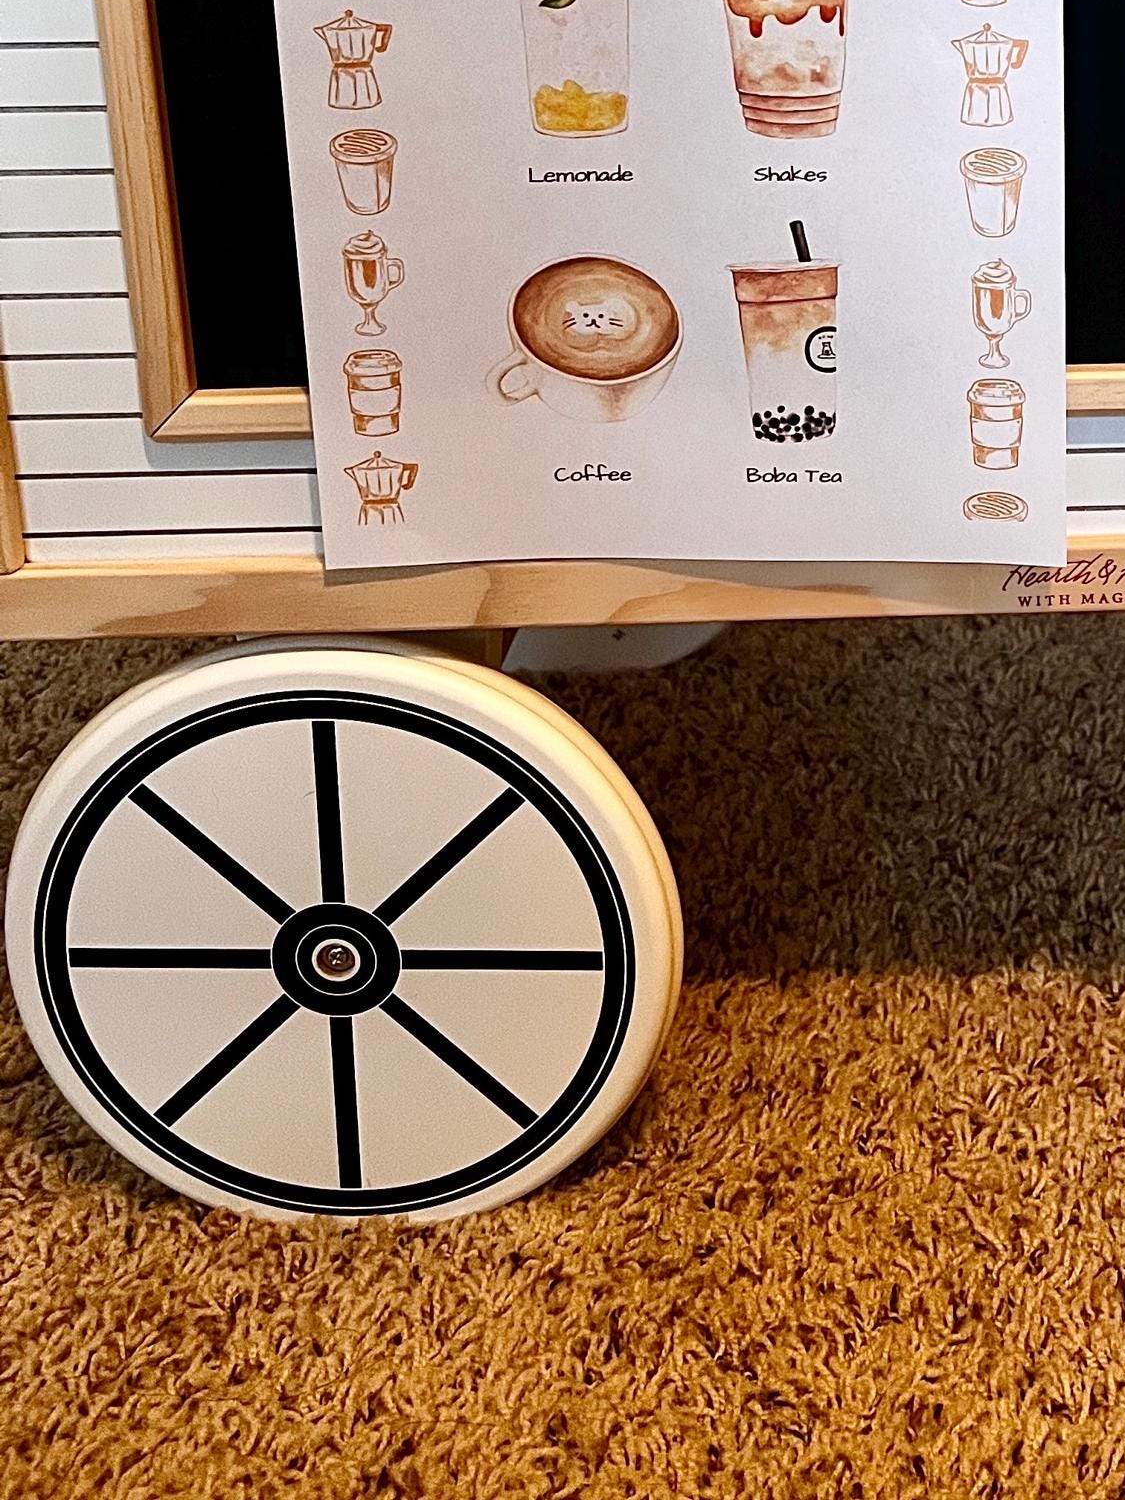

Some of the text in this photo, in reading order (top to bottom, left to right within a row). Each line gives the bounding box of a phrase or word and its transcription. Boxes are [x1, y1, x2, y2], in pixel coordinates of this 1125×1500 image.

[528, 164, 634, 183] Lemonade
[753, 165, 828, 183] Shakes
[553, 463, 632, 483] Coffee
[746, 466, 843, 483] Boba Tea
[1002, 553, 1103, 591] Hearth
[1098, 558, 1117, 585] &
[1018, 594, 1071, 607] WITH
